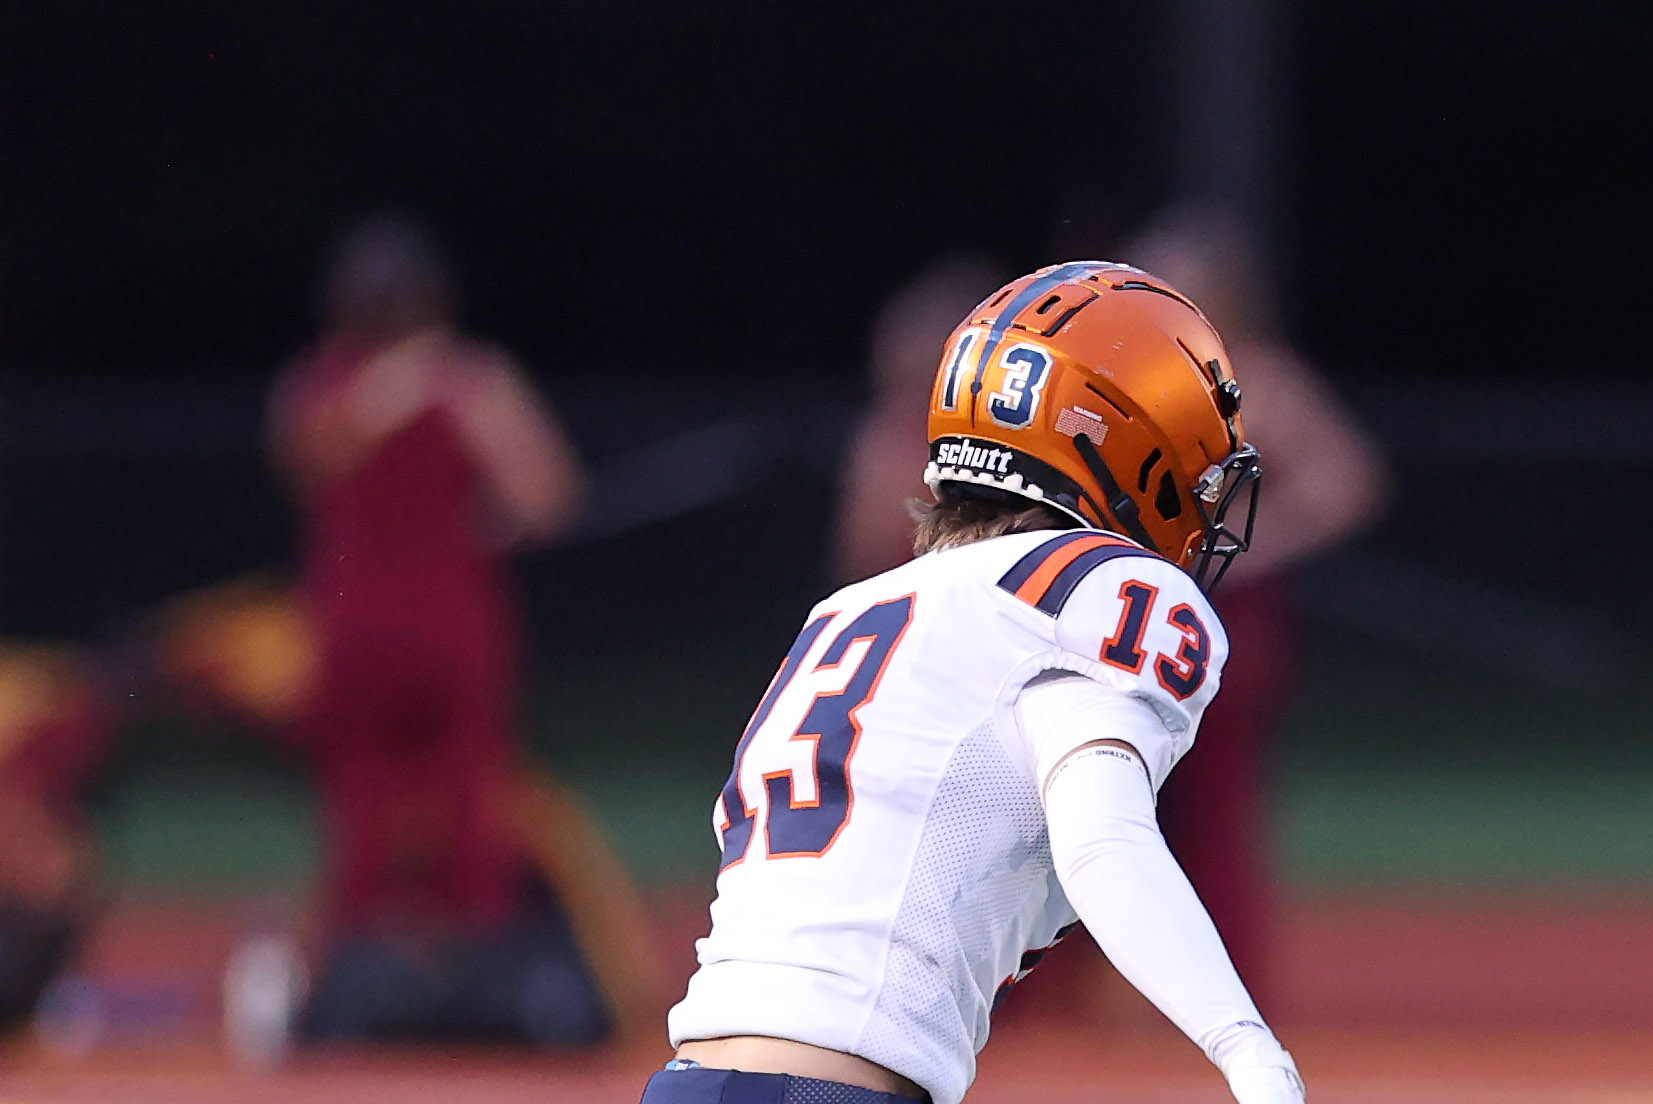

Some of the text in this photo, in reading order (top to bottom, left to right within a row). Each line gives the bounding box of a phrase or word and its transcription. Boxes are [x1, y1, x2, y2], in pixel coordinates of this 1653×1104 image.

[942, 327, 1054, 431] 13
[937, 439, 1013, 473] schutt
[1100, 579, 1211, 700] 13
[718, 591, 917, 874] 13
